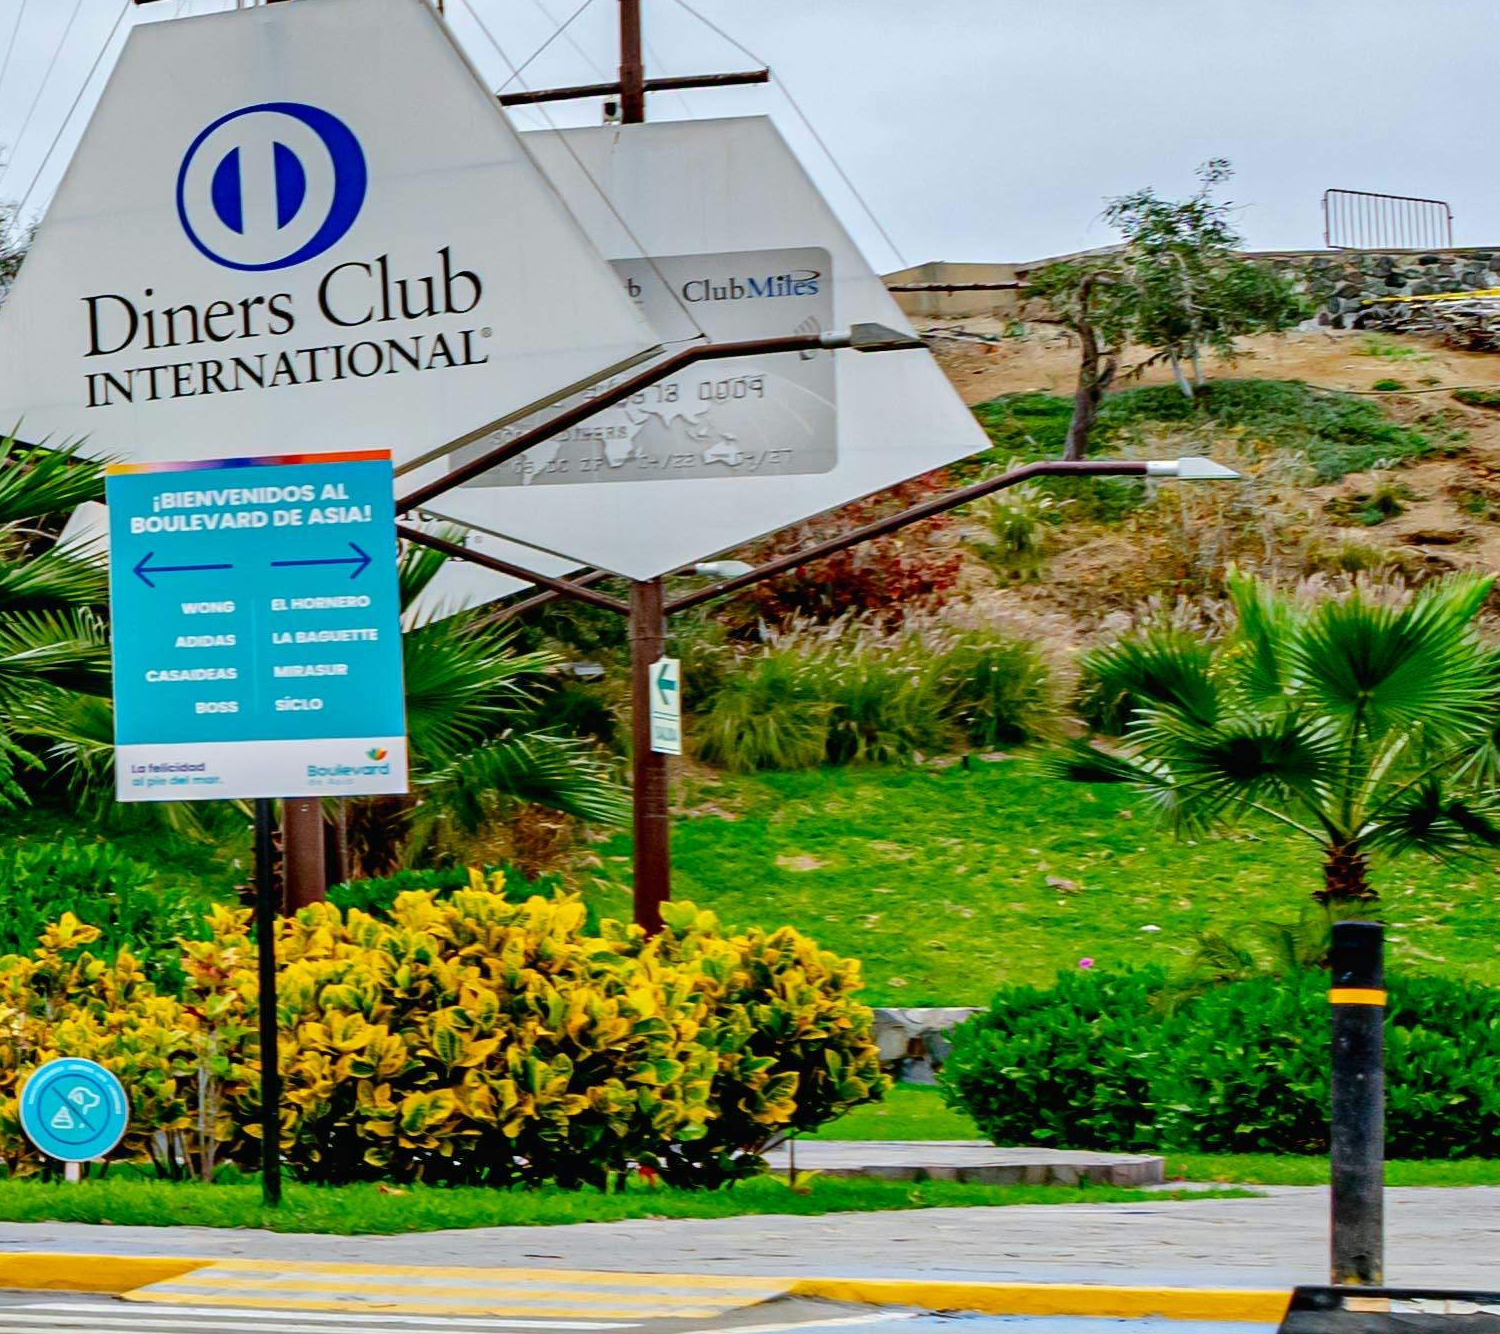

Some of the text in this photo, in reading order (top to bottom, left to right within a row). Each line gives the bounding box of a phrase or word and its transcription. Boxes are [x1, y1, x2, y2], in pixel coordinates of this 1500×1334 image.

[682, 272, 820, 303] ClubMiles
[80, 245, 482, 358] Diners Club
[153, 483, 349, 513] ¡BIENVENIDOS AL
[130, 505, 372, 535] BOULEVARD DE ASIA!
[181, 601, 236, 615] WONG
[271, 595, 371, 611] EL HORNERO
[175, 634, 237, 648] ADIDAS
[272, 628, 379, 644] LA BAGUETTE
[145, 668, 238, 683] CASAIDEAS
[273, 664, 349, 678] MIRASUR
[195, 701, 239, 714] BOSS
[274, 696, 323, 711] SÍCLO
[131, 762, 206, 774] La felicidad
[307, 763, 390, 777] Boulevard
[132, 777, 144, 787] al
[169, 775, 189, 785] del
